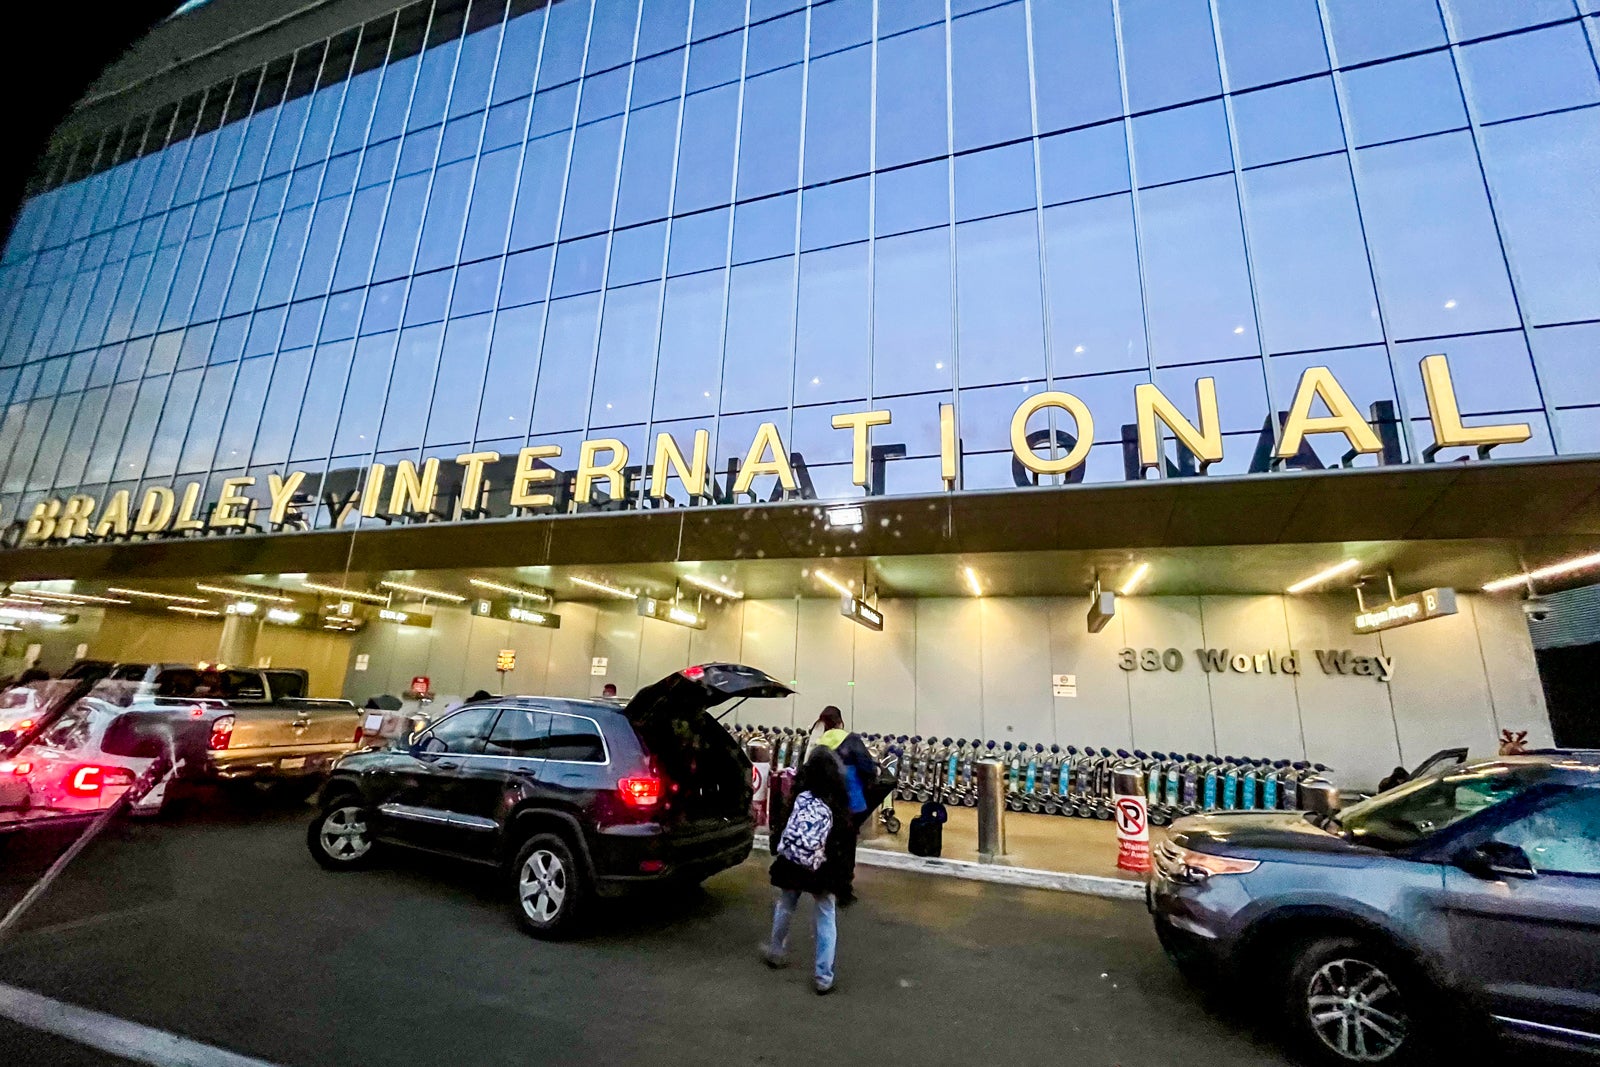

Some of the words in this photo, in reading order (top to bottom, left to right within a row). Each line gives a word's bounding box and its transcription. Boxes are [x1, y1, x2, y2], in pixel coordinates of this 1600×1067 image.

[20, 471, 306, 544] BRADLEY
[362, 354, 1532, 518] INTERNATIONAL
[341, 603, 350, 614] B
[480, 602, 488, 613] B
[647, 601, 655, 613] B
[1426, 594, 1436, 611] B
[1118, 647, 1184, 673] 380
[1196, 648, 1301, 675] World
[1315, 648, 1396, 683] Way
